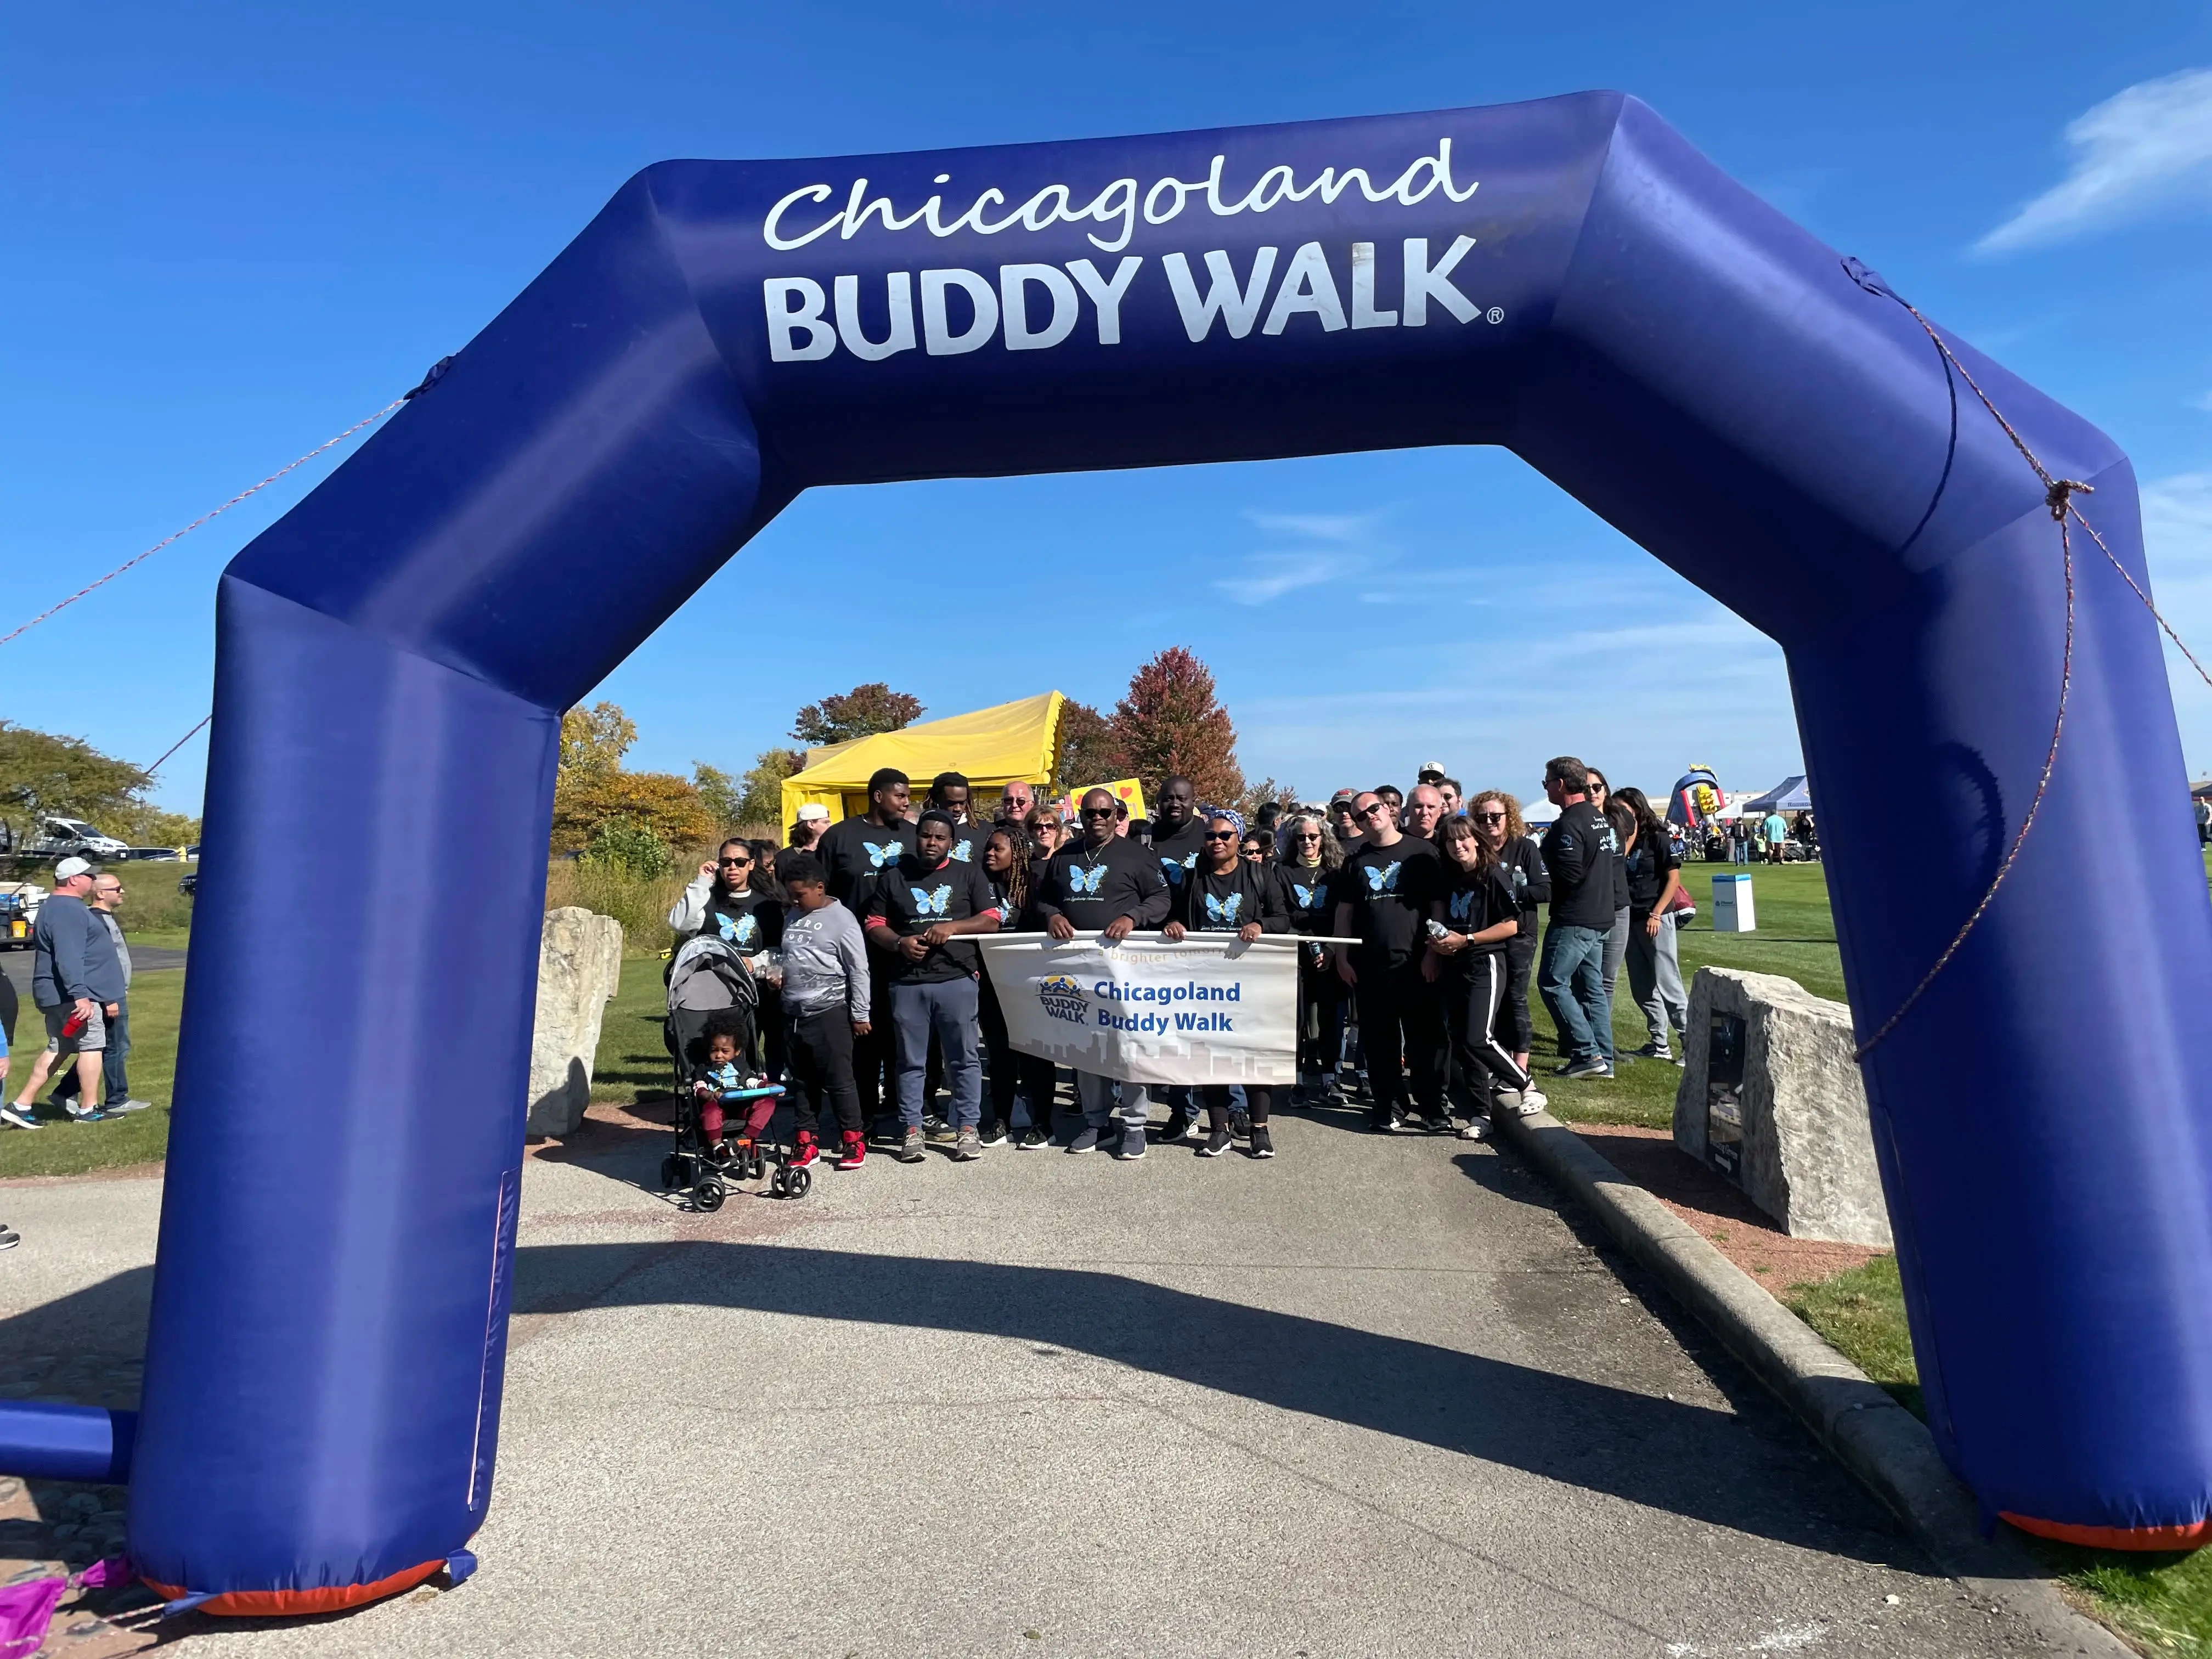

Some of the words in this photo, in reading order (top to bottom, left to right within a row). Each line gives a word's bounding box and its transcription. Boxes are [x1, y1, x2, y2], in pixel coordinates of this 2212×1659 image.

[763, 137, 1479, 252] Chicagoland
[763, 256, 1143, 363] BUDDY
[1111, 949, 1168, 964] brighter
[1174, 947, 1245, 960] tomorrow
[1040, 996, 1089, 1013] BUDDY
[1094, 981, 1240, 1006] Chicagoland
[1098, 1008, 1169, 1036] Buddy
[1174, 1012, 1233, 1031] Walk
